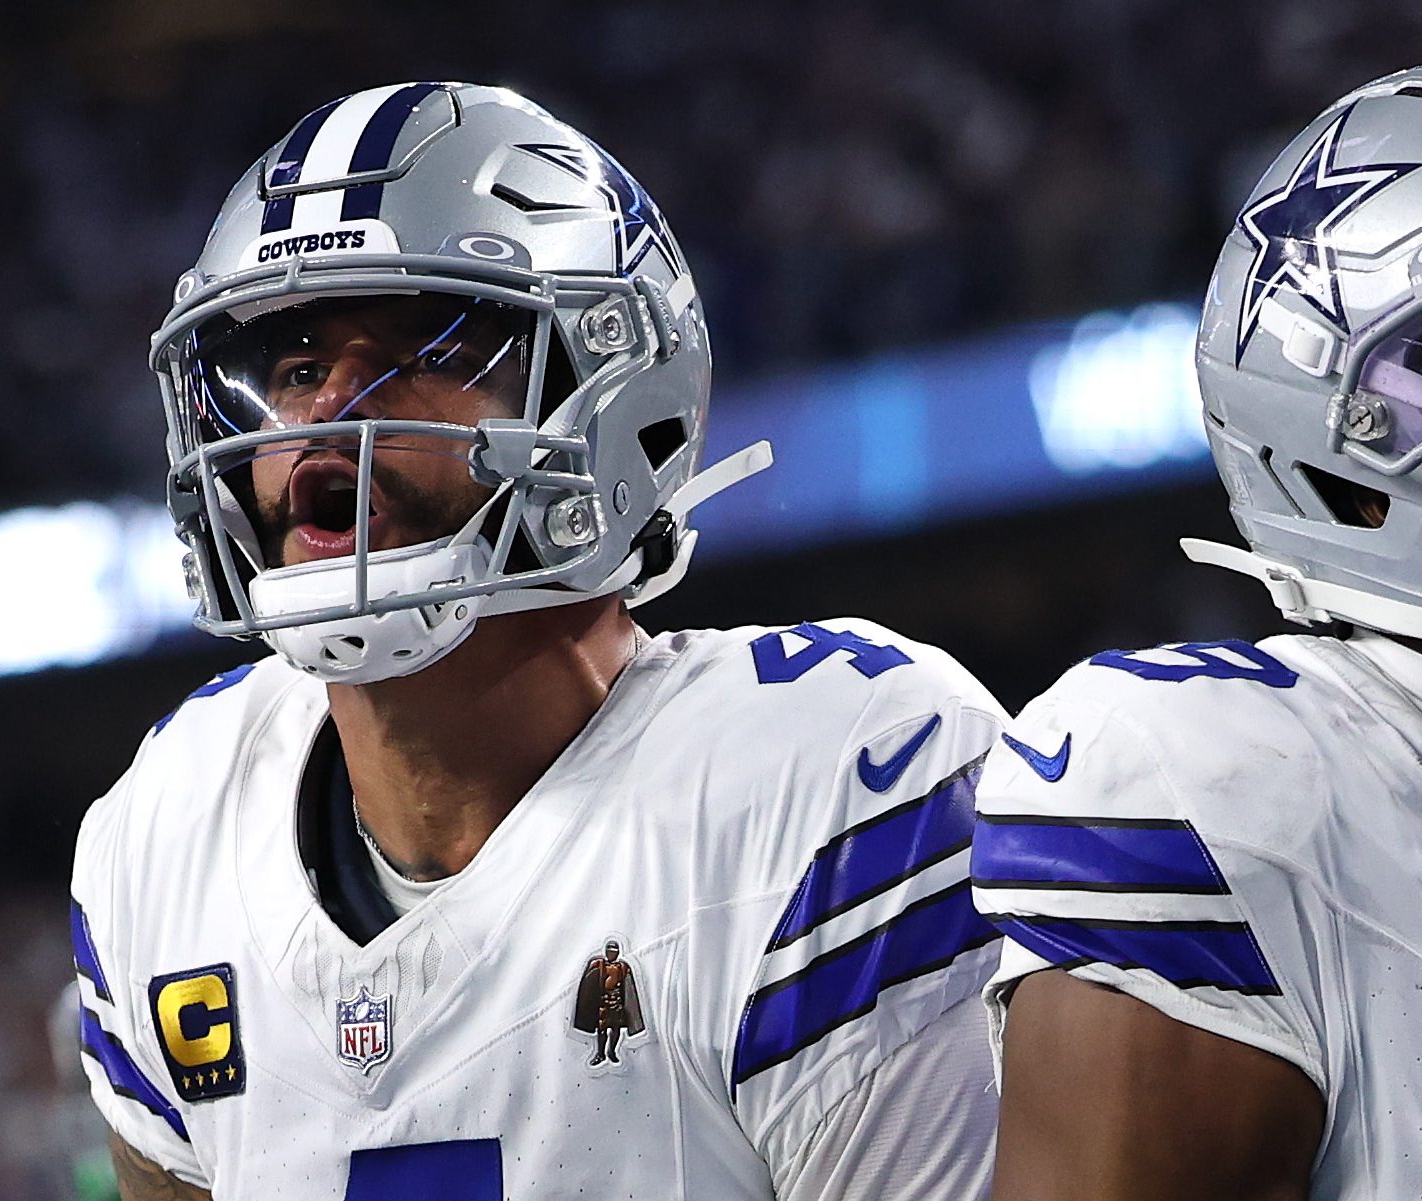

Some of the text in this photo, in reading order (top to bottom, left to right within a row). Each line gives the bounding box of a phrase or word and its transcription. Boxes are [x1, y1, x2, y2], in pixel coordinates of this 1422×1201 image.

[258, 230, 366, 263] COWBOYS
[157, 974, 232, 1068] C
[344, 1025, 383, 1058] NFL
